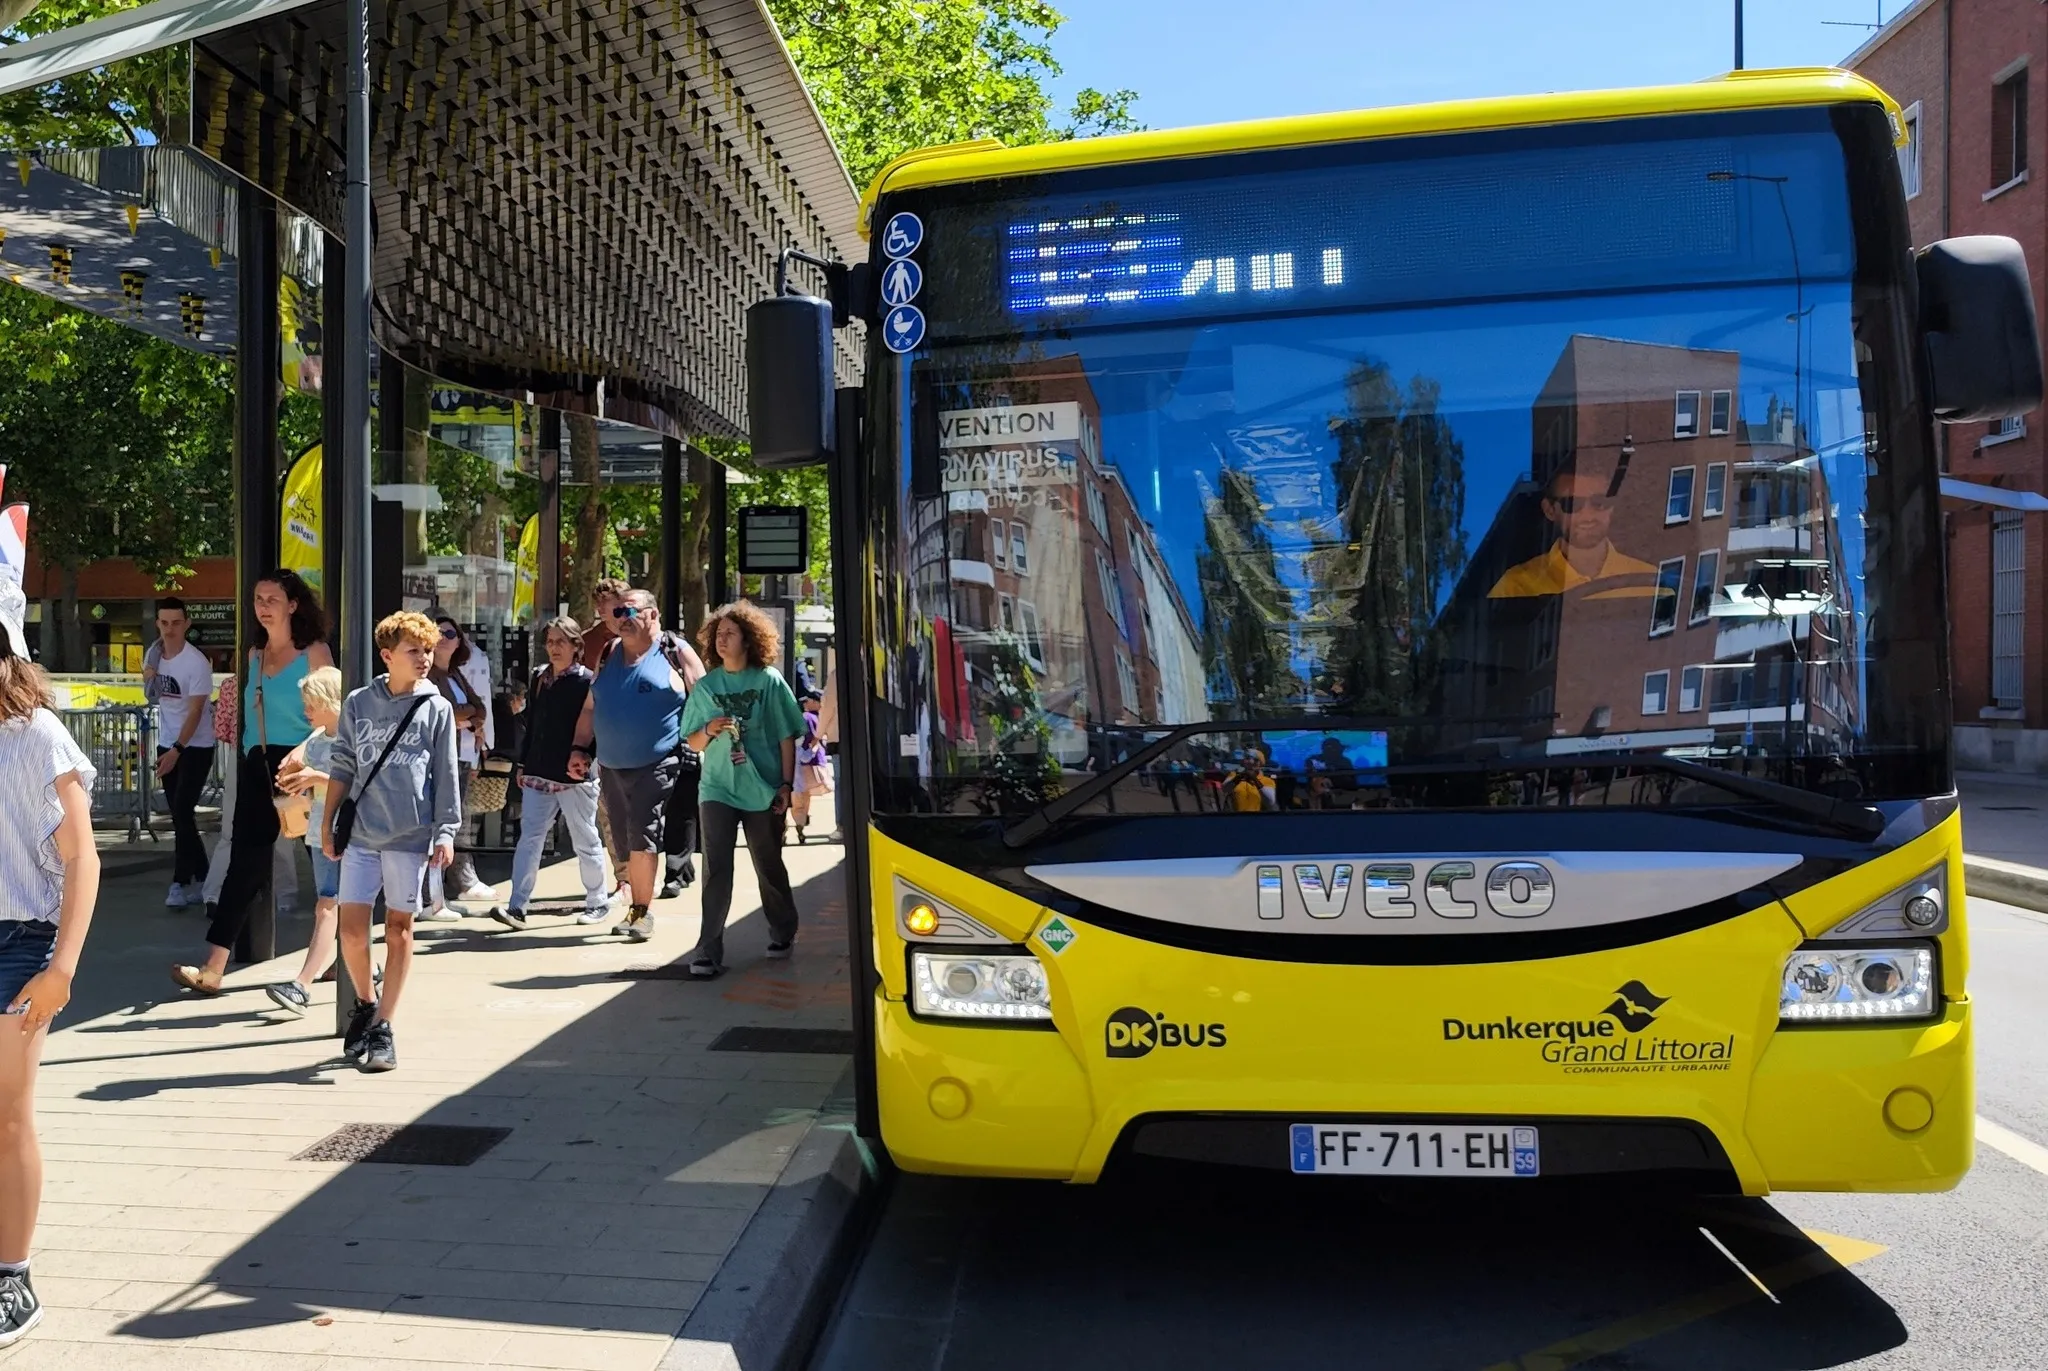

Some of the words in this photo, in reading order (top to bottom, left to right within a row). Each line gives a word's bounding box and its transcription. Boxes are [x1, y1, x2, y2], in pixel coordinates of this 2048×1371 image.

[939, 411, 1055, 438] VENTION
[356, 718, 422, 746] Deelxe
[1256, 861, 1556, 920] IVECO
[1042, 928, 1072, 942] GNC
[1442, 1016, 1614, 1044] Dunkerque
[1541, 1037, 1628, 1063] Grand
[1635, 1035, 1734, 1061] Littoral
[1671, 1063, 1732, 1072] URBAINE
[1319, 1131, 1510, 1168] FF-711-EH
[1515, 1152, 1536, 1170] 59
